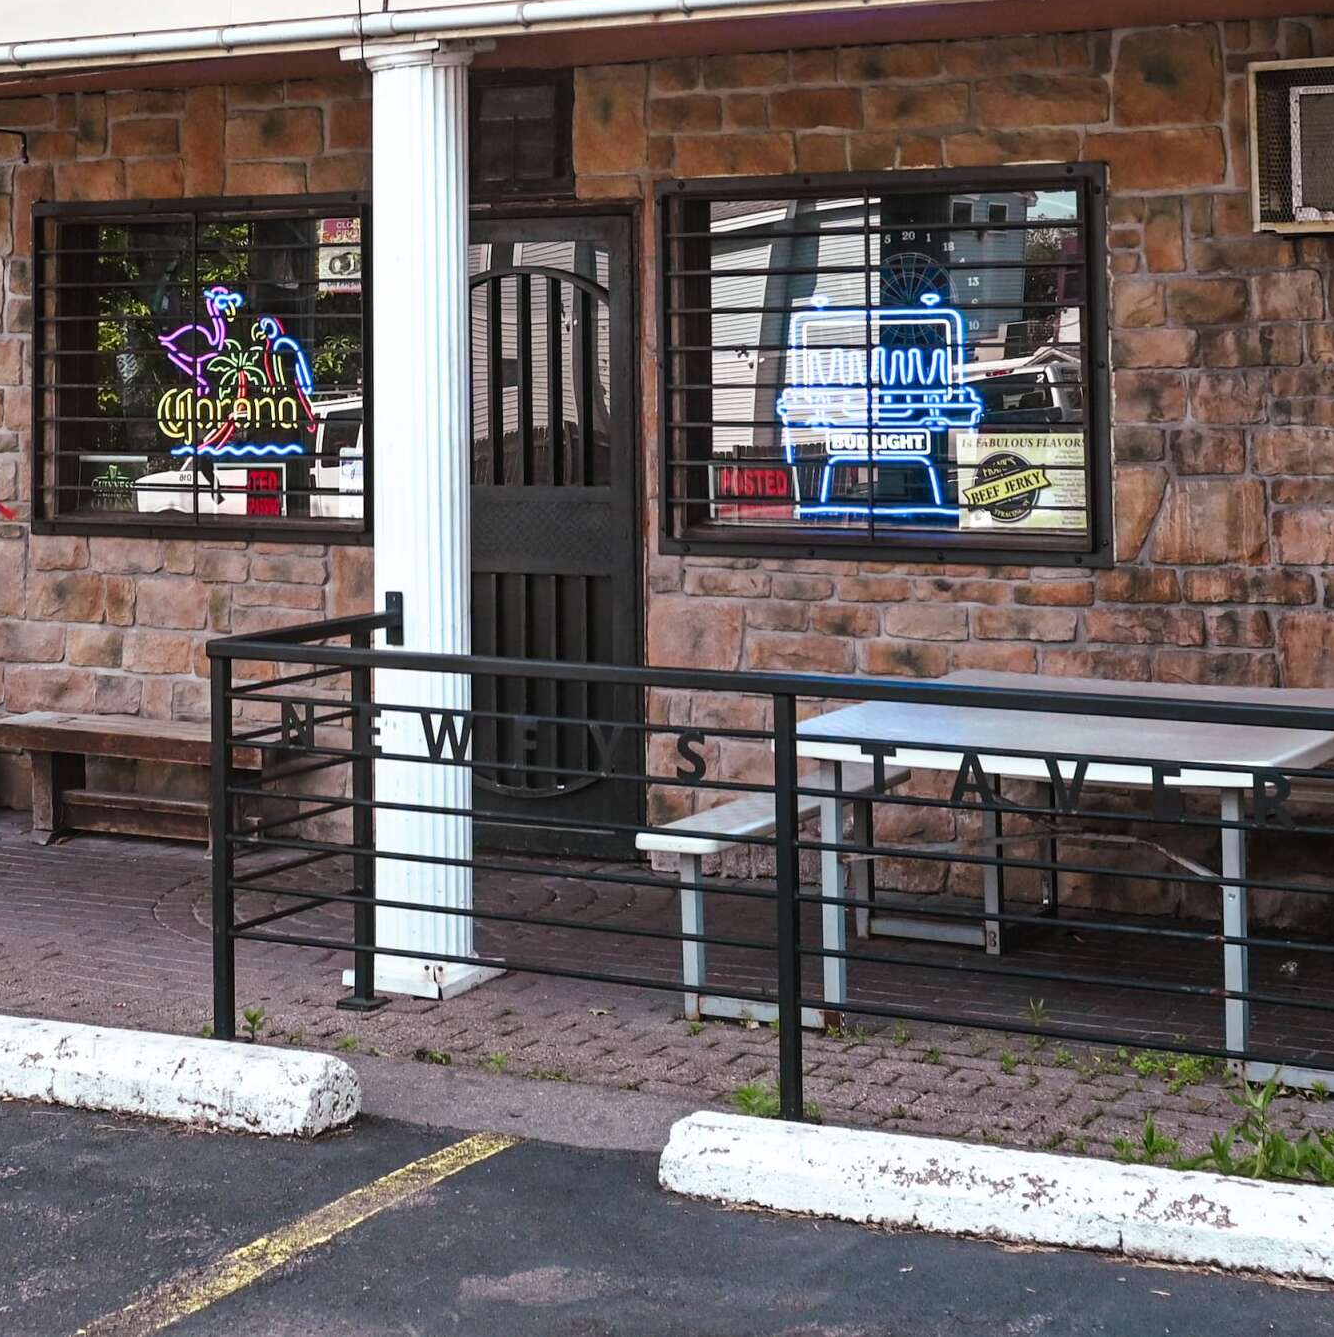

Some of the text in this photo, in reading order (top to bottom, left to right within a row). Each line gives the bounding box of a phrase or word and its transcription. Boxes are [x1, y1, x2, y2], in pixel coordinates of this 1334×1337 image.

[157, 388, 298, 445] Corona
[830, 433, 926, 450] BUD LIGHT
[975, 438, 1035, 449] FABULOUS
[970, 485, 1001, 505] BEEF
[1003, 471, 1042, 495] JERKY
